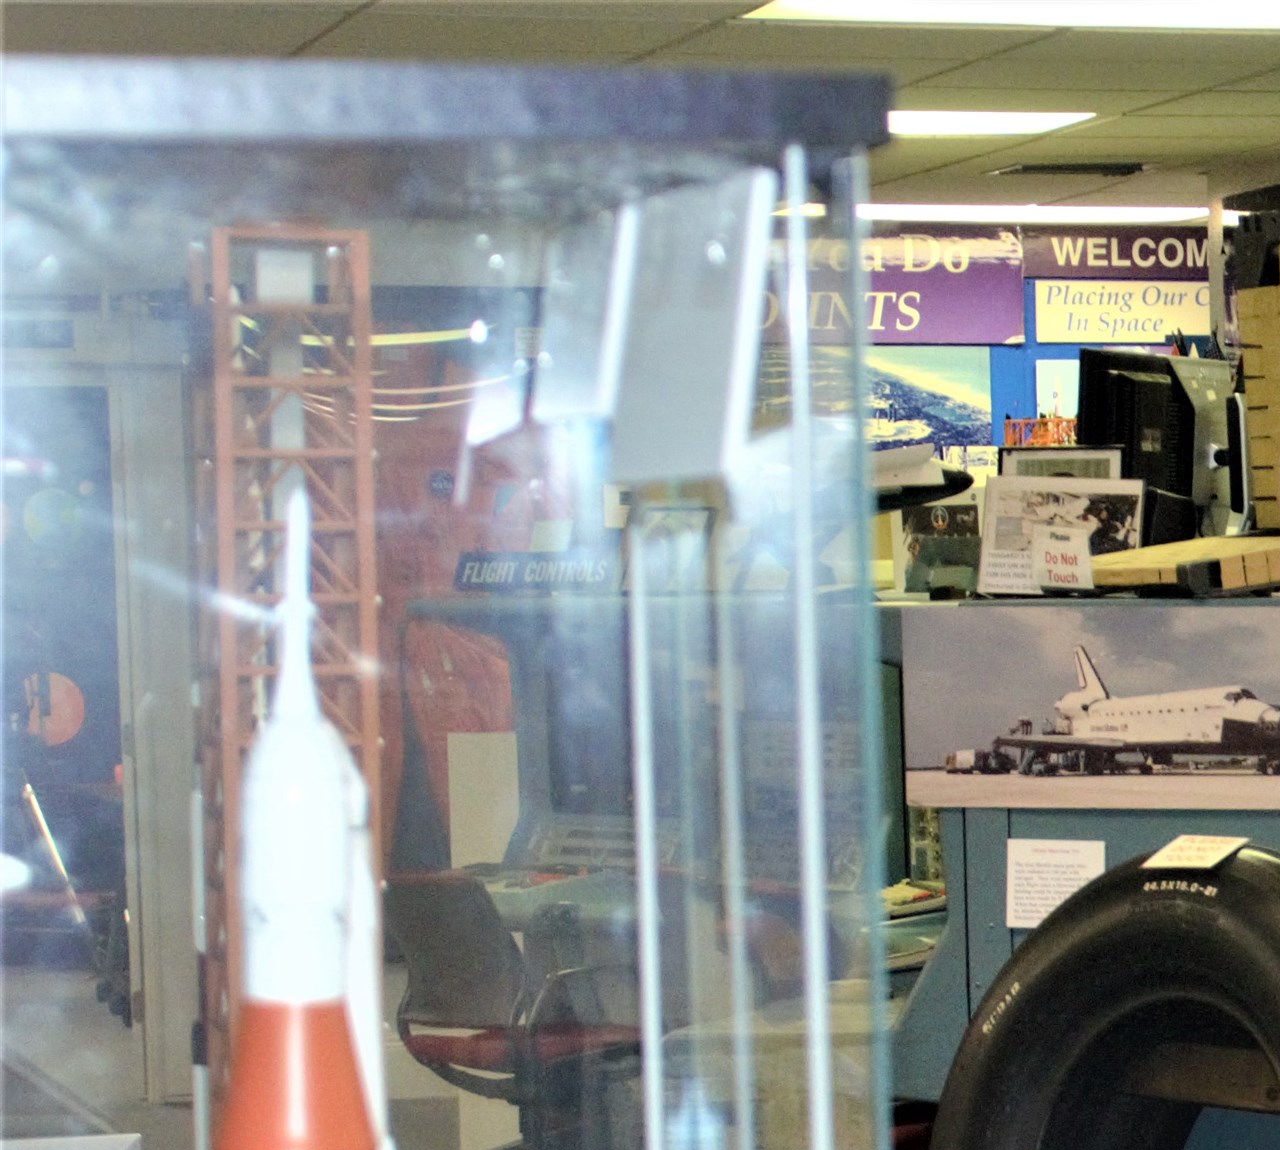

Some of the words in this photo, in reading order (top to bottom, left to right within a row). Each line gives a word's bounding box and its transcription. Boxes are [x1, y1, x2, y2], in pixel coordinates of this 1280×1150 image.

[900, 233, 970, 273] Do
[1050, 237, 1209, 268] WELCOM
[1045, 285, 1134, 313] Placing
[1141, 285, 1188, 307] Our
[1067, 312, 1089, 332] In
[1098, 311, 1164, 338] Space
[462, 560, 518, 583] FLIGHT
[523, 560, 607, 583] CONTROLS
[1045, 551, 1058, 565] Do
[1060, 552, 1078, 567] Not
[1047, 569, 1079, 584] Touch
